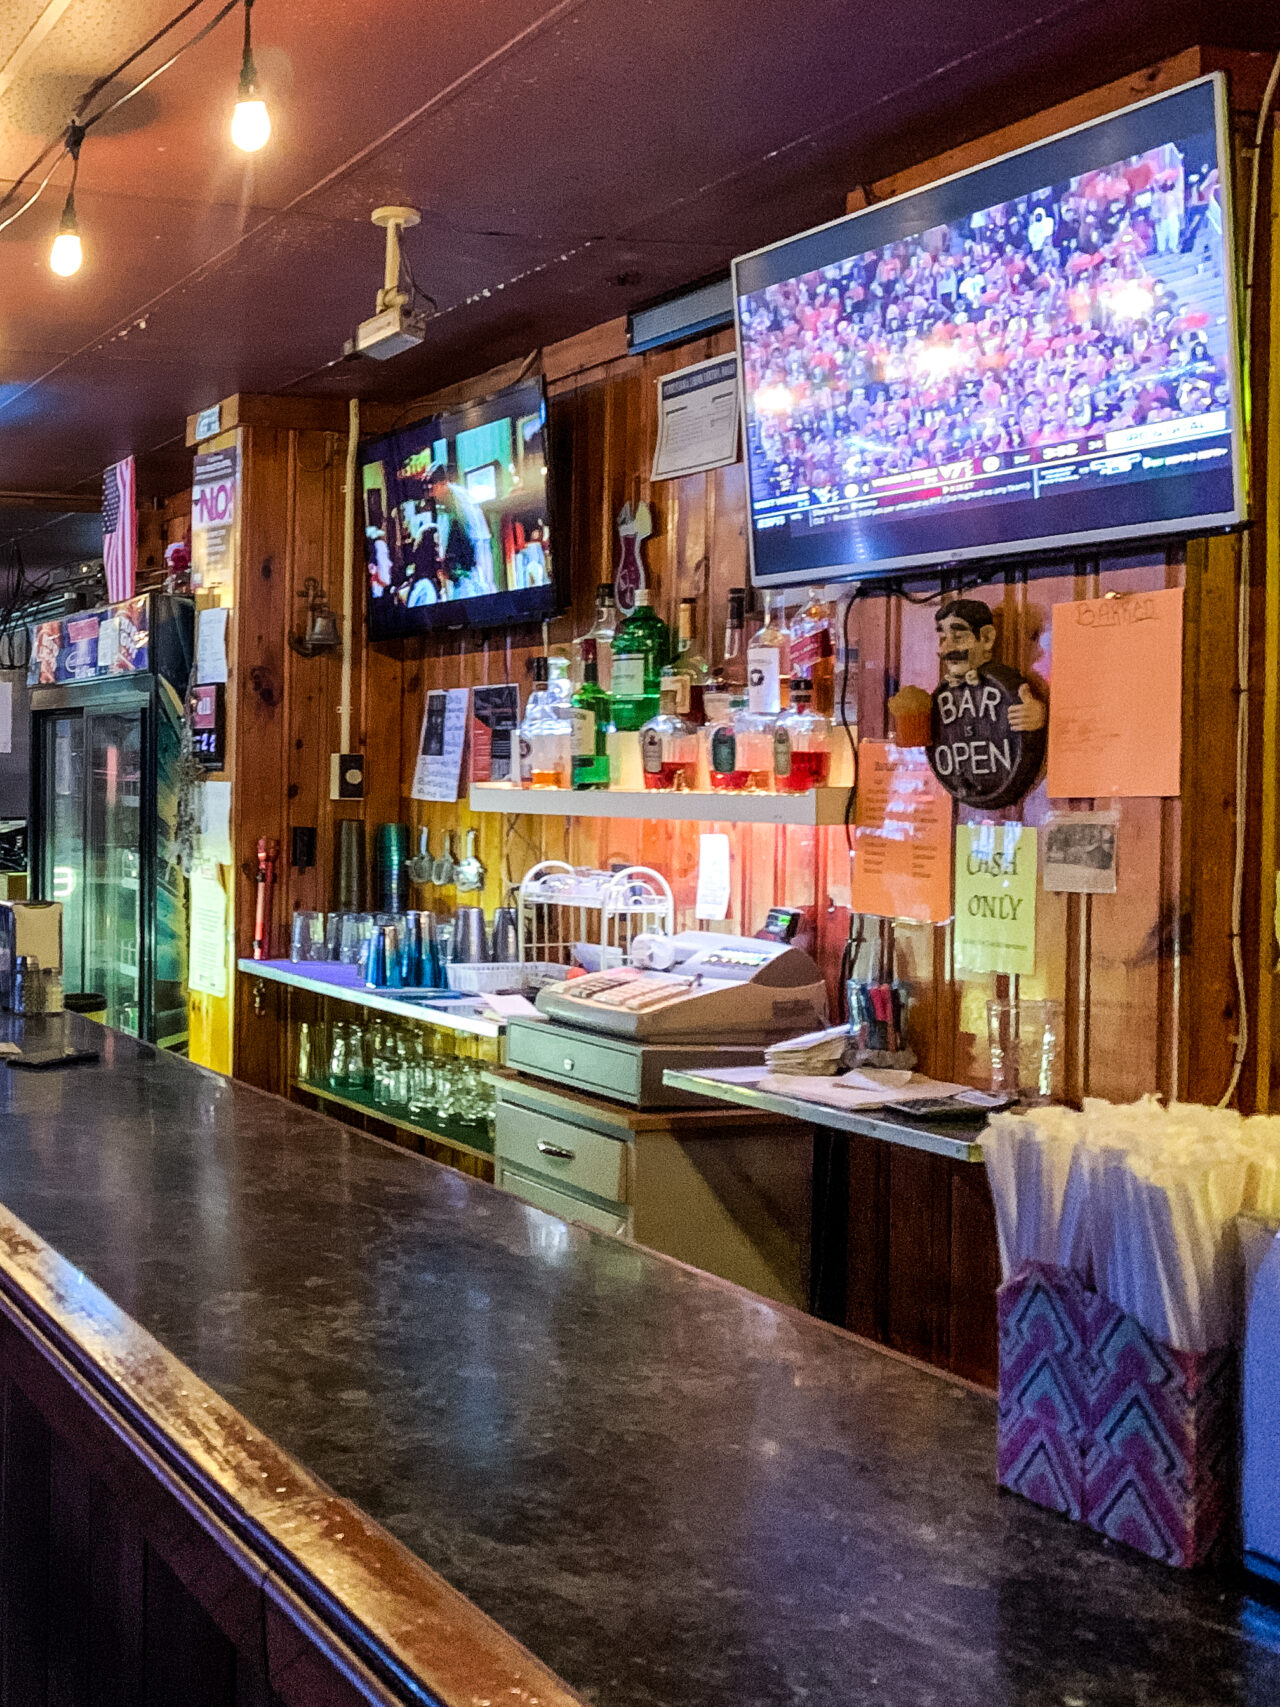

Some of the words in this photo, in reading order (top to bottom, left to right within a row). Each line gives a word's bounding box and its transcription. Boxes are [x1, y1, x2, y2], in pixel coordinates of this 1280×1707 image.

[937, 686, 1001, 725] BAR
[935, 738, 1012, 775] OPEN
[967, 893, 1024, 921] ONLY
